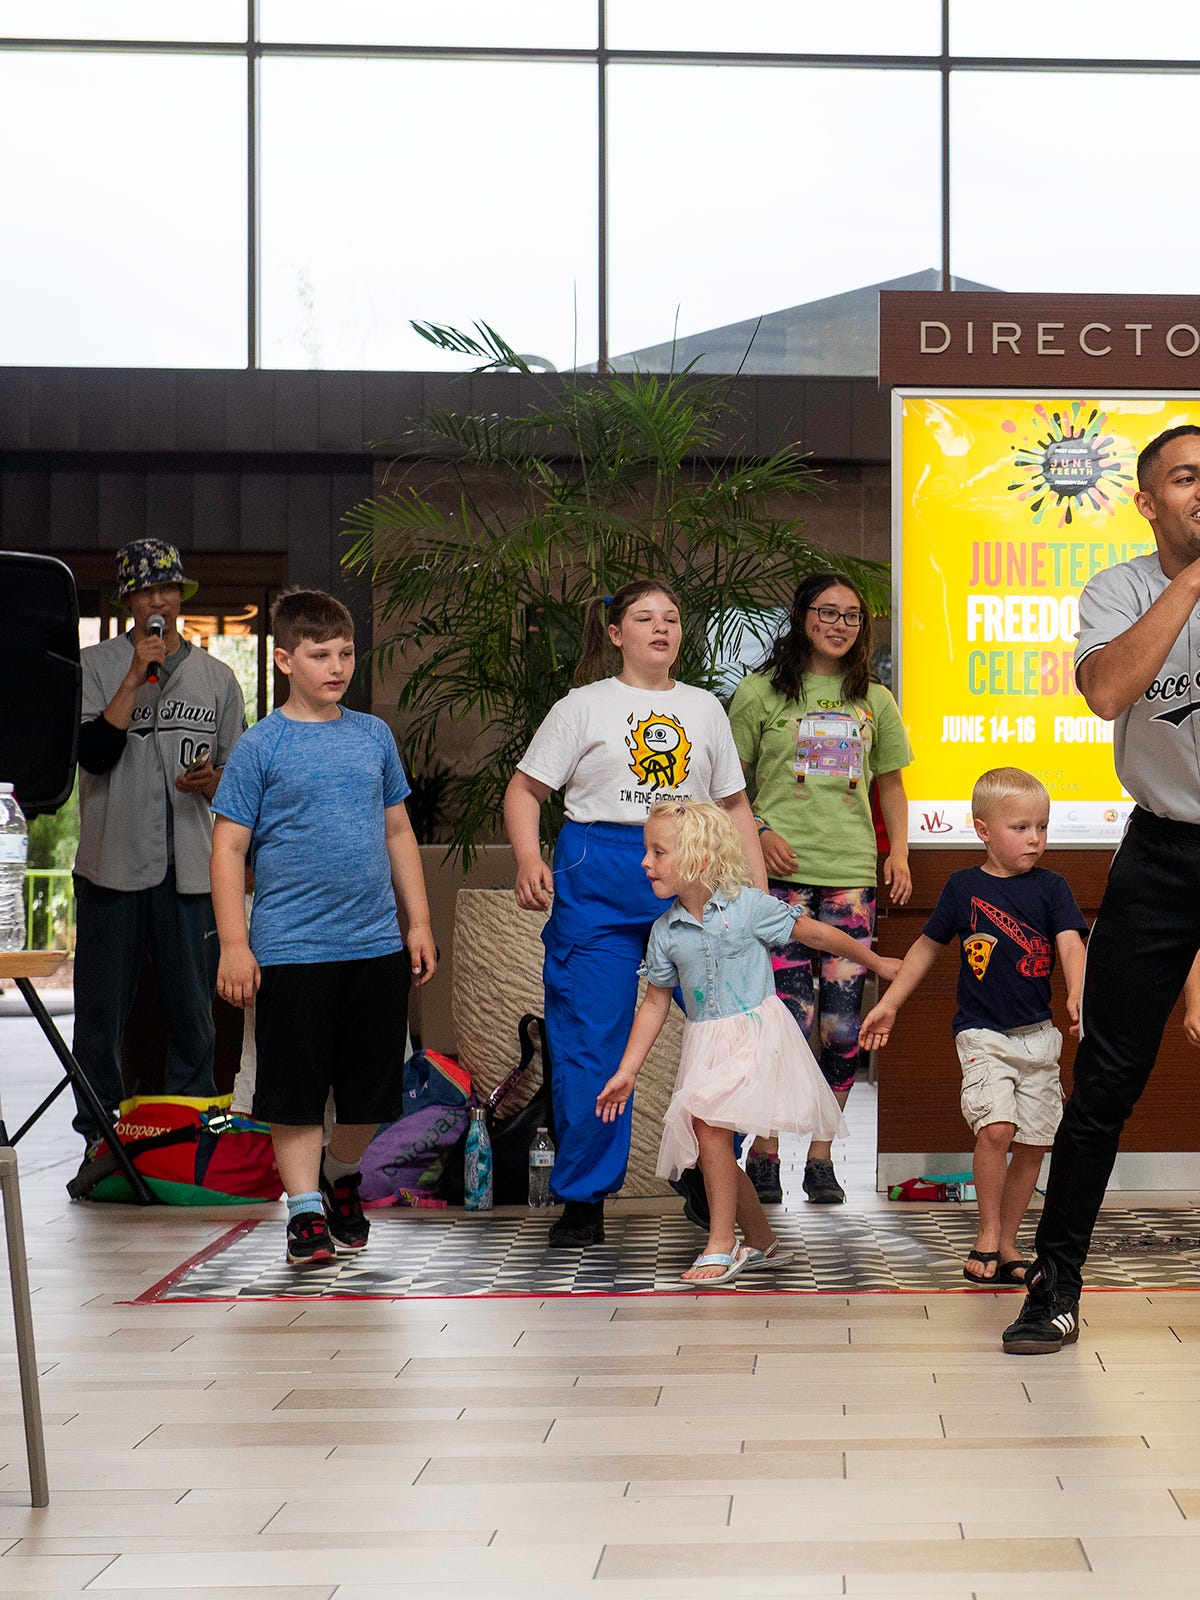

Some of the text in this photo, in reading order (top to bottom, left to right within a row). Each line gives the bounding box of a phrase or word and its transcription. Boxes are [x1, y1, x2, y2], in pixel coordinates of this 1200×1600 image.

[1050, 458, 1092, 468] JUNE
[1050, 467, 1093, 476] TEENTH
[969, 541, 1158, 587] JUNETEEN
[967, 594, 1080, 642] FREEDO
[968, 650, 1079, 695] CELEBR
[1144, 674, 1191, 701] oco
[131, 700, 216, 723] co Flava
[820, 700, 842, 709] CSU
[941, 715, 1114, 743] JUNE 14-16 FOOTHI
[620, 789, 632, 802] I'M
[634, 791, 651, 804] FINE
[116, 1123, 171, 1139] otopax
[382, 1109, 465, 1178] cotopax
